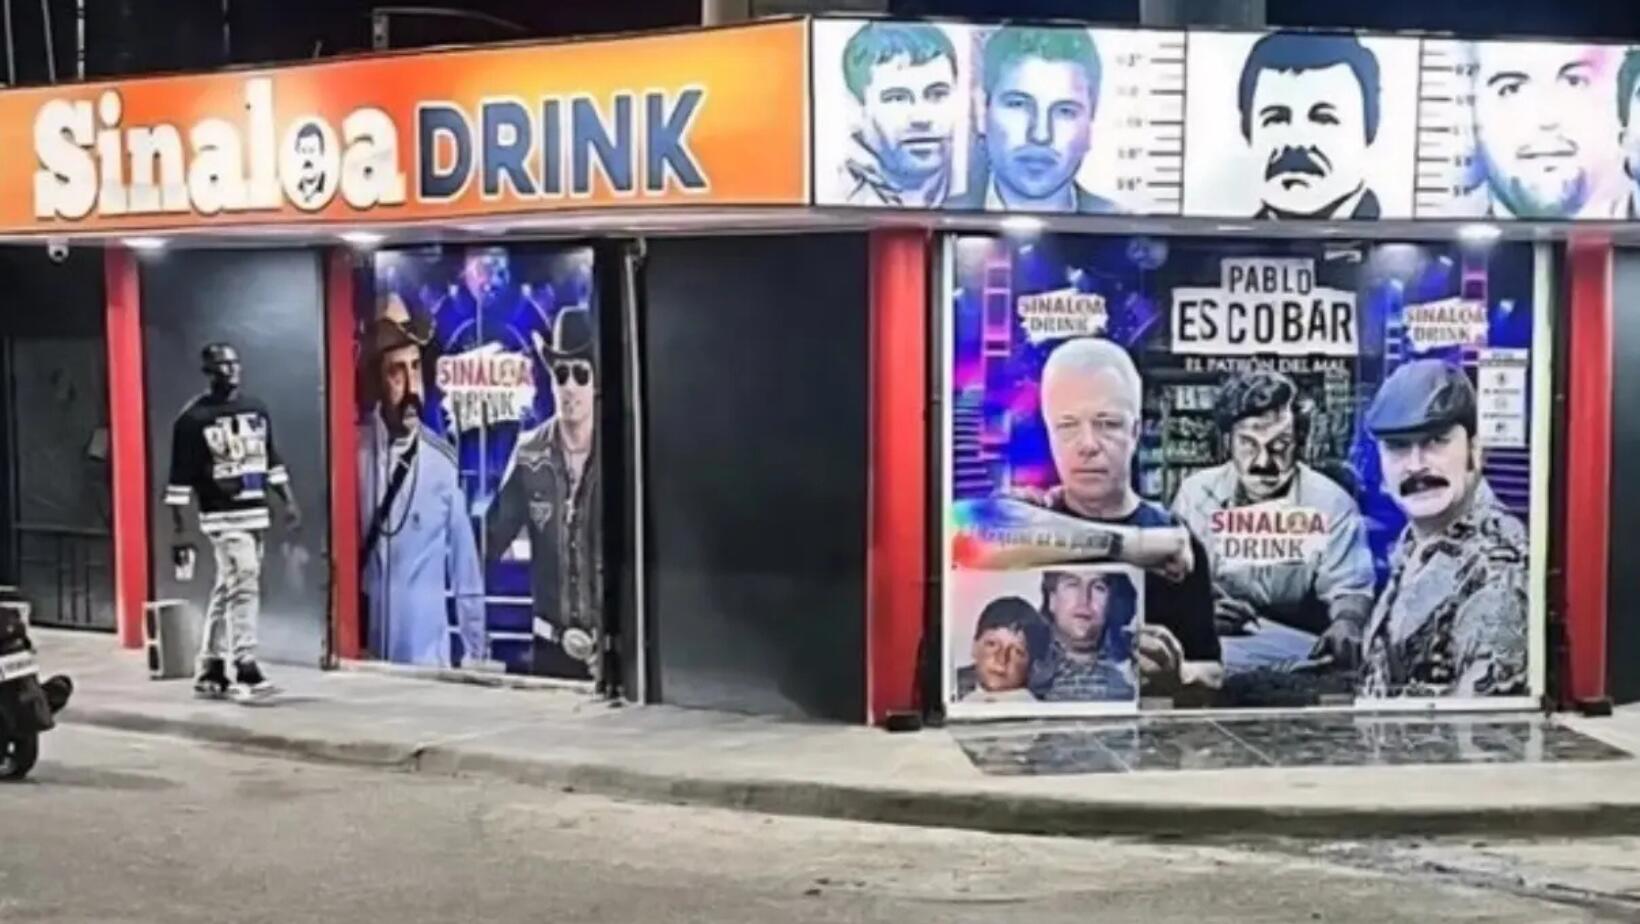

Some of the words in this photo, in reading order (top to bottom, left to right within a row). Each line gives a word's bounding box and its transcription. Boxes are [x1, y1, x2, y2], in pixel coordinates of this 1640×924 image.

[34, 78, 405, 219] Sinaloa
[418, 88, 708, 200] DRINK
[1229, 265, 1312, 295] PABLO
[1178, 298, 1353, 344] ESCOBAR
[440, 356, 532, 387] SINALOA
[1210, 511, 1326, 534] SINALOA
[1225, 537, 1304, 560] DRINK
